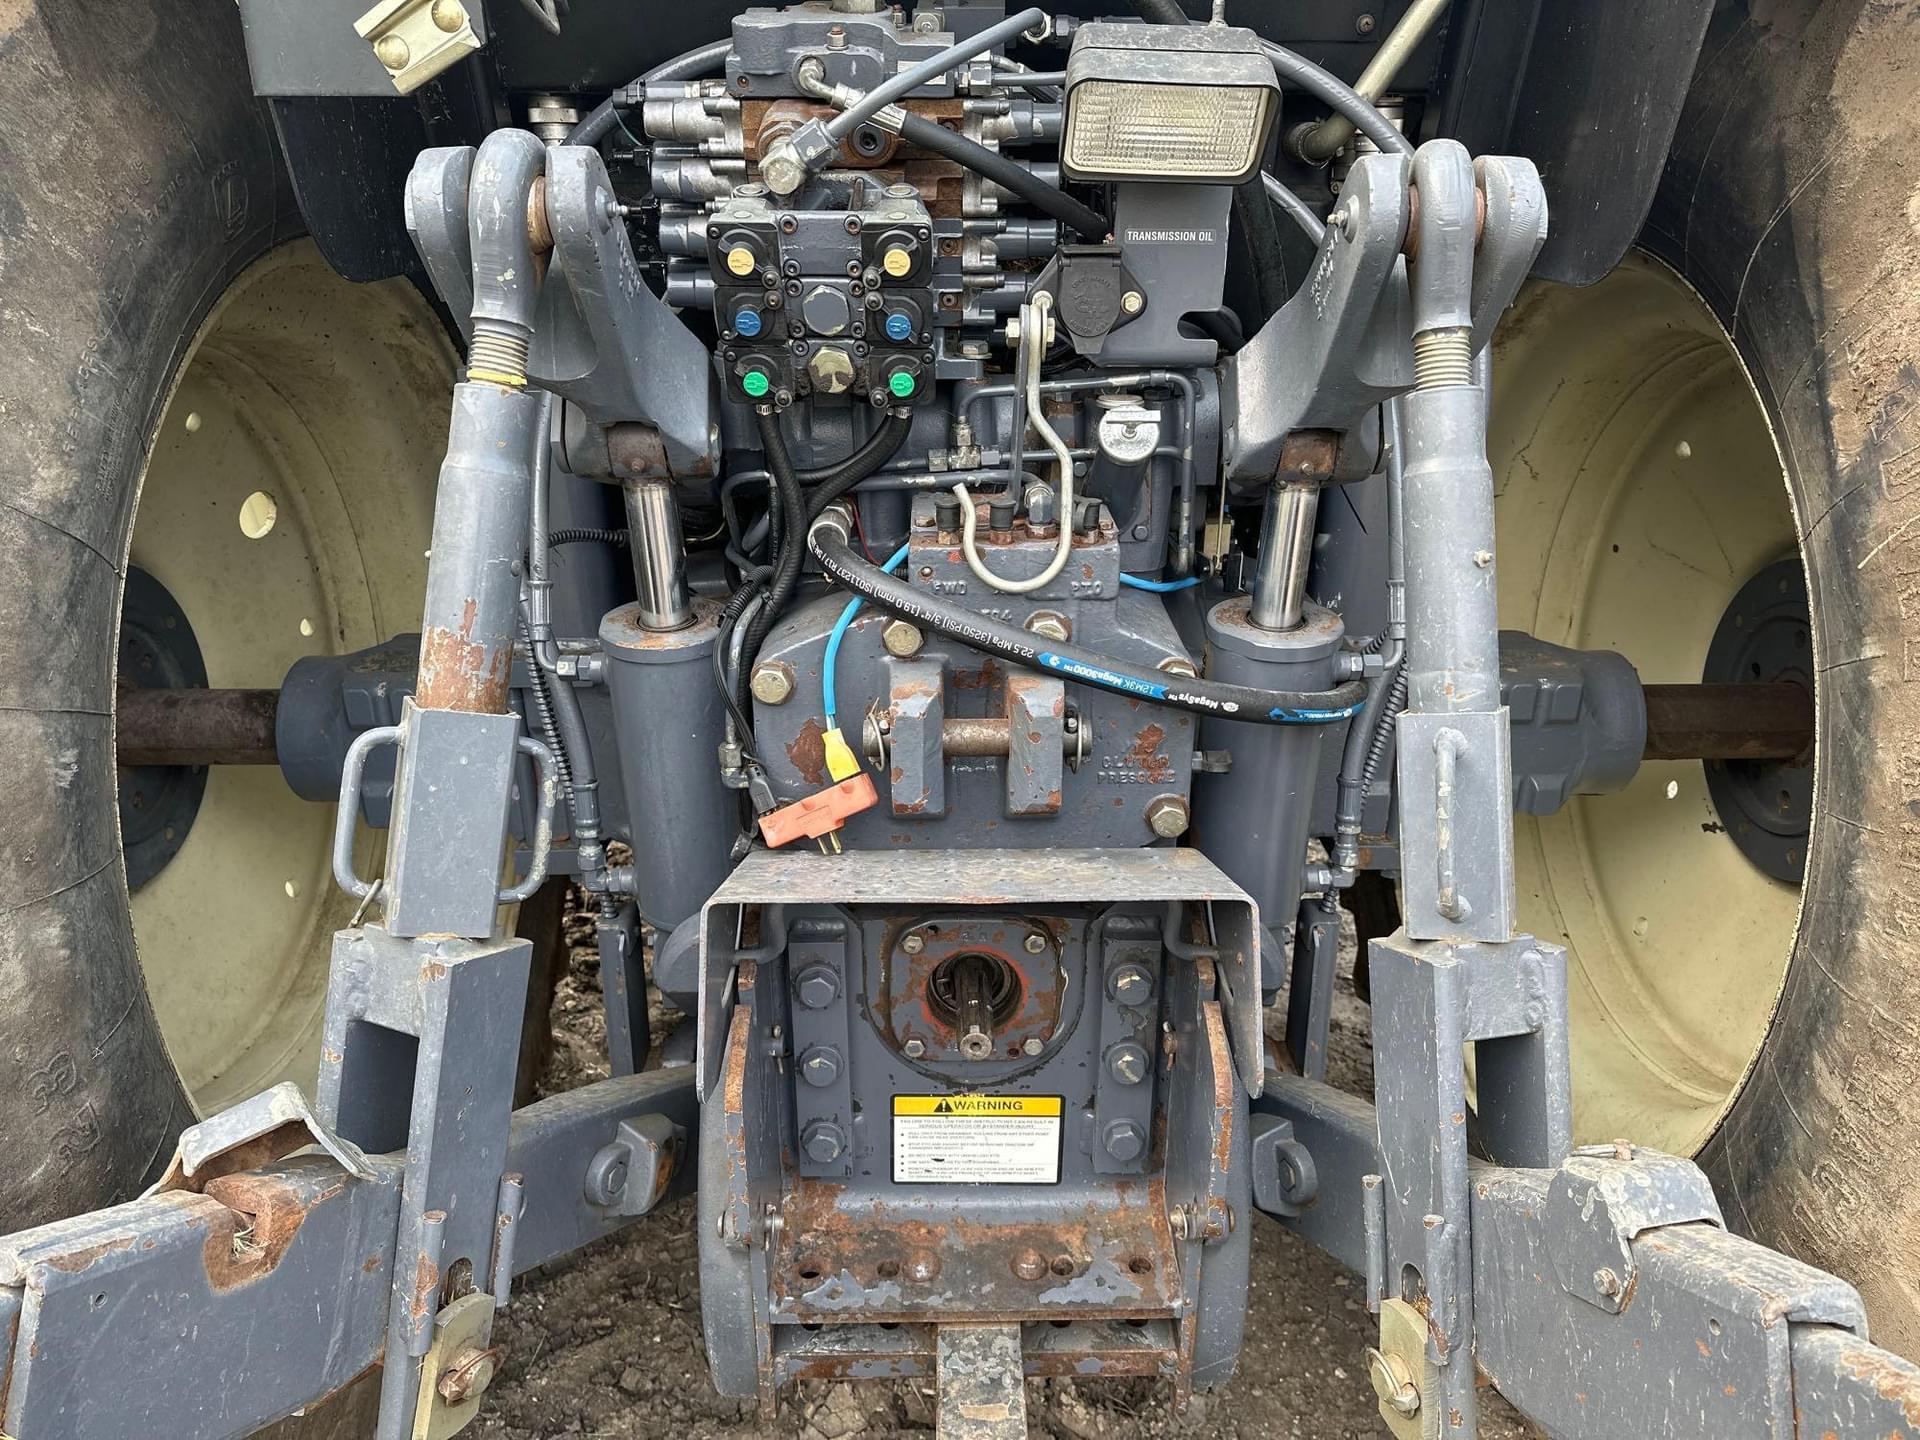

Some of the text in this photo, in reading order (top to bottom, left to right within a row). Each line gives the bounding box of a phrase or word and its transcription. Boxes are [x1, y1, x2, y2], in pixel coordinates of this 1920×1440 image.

[1127, 231, 1214, 241] TRANSMISSION OIL
[825, 559, 838, 572] R17
[1069, 580, 1105, 596] PTO
[992, 636, 1013, 651] MPa
[1013, 644, 1034, 659] 22.5
[1122, 680, 1155, 695] 12M3K
[954, 1100, 1023, 1111] WARNING
